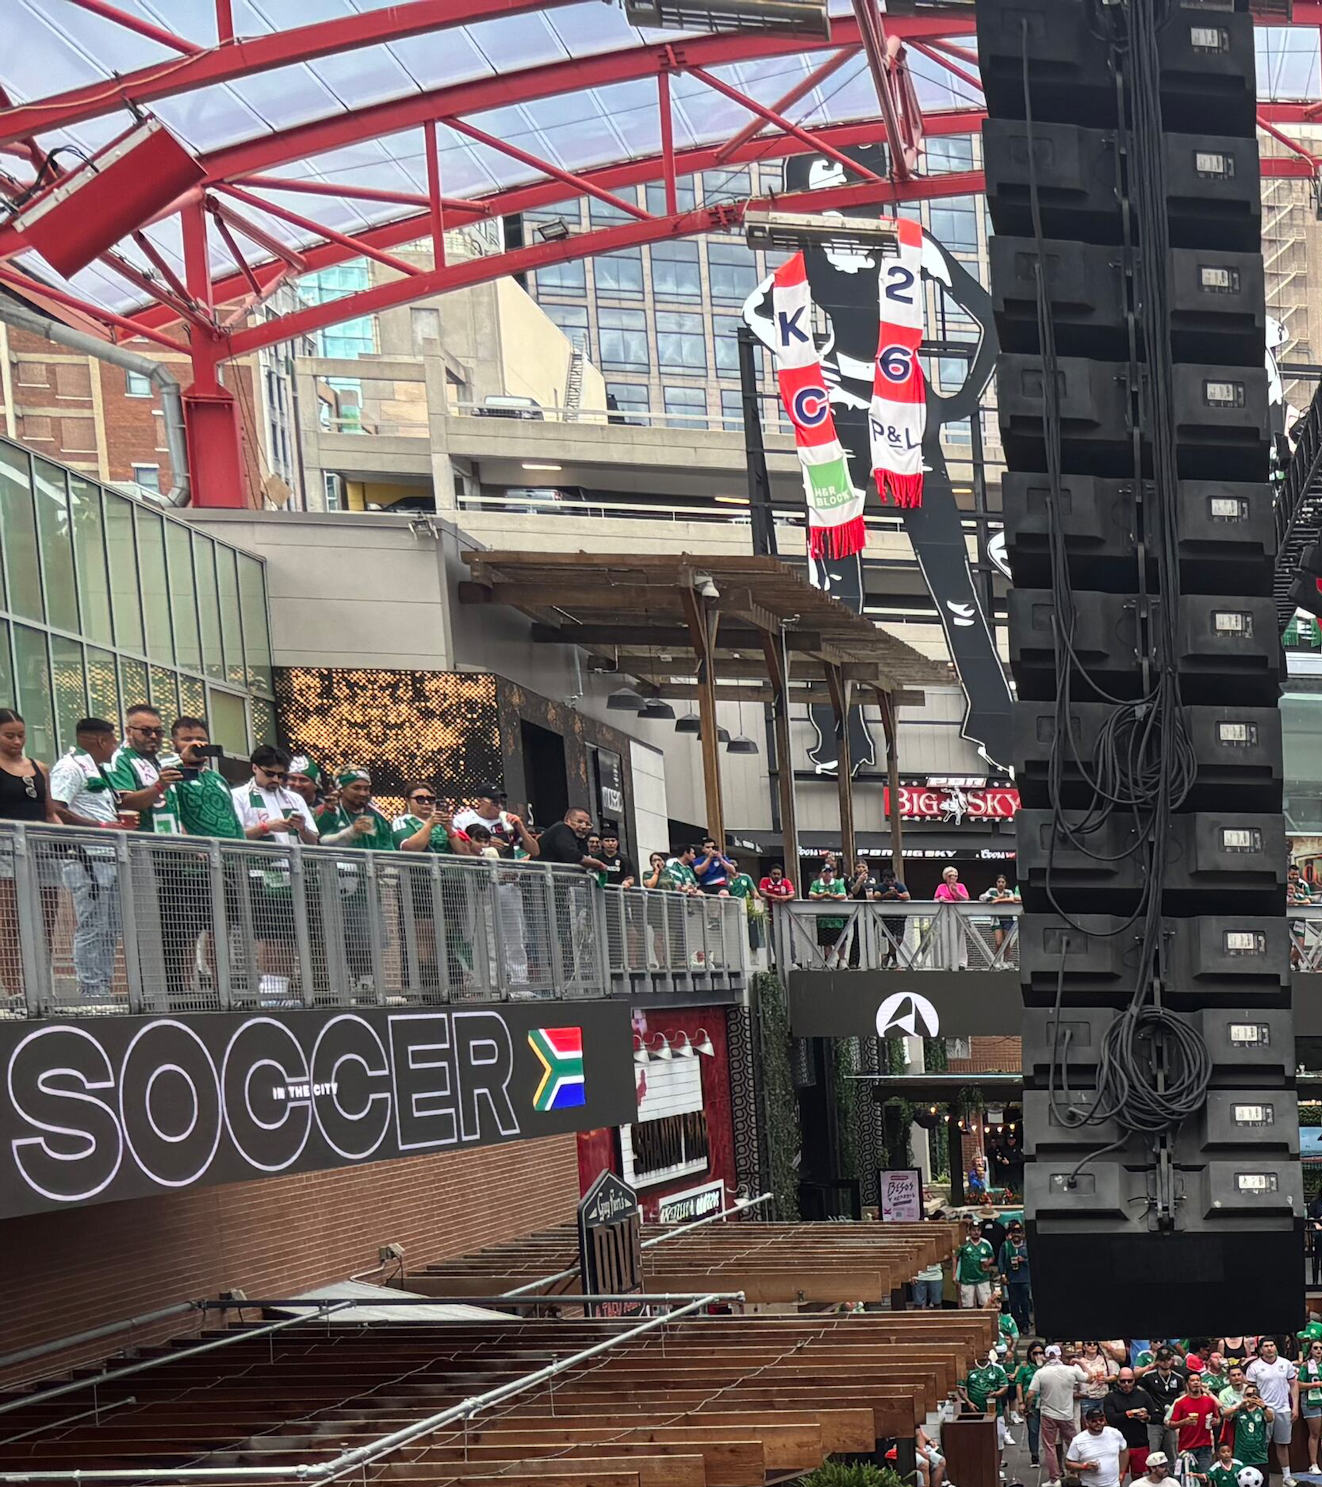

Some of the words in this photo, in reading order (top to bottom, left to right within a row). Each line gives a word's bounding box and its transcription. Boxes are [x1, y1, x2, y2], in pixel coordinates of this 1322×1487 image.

[885, 266, 914, 304] 2
[779, 306, 810, 347] K
[879, 346, 914, 383] 6
[792, 386, 829, 427] C
[871, 419, 922, 450] P&L
[966, 788, 1021, 815] SKY
[8, 1011, 521, 1201] SOCCER
[272, 1087, 285, 1100] IN
[287, 1084, 311, 1098] THE
[313, 1082, 338, 1097] CITY
